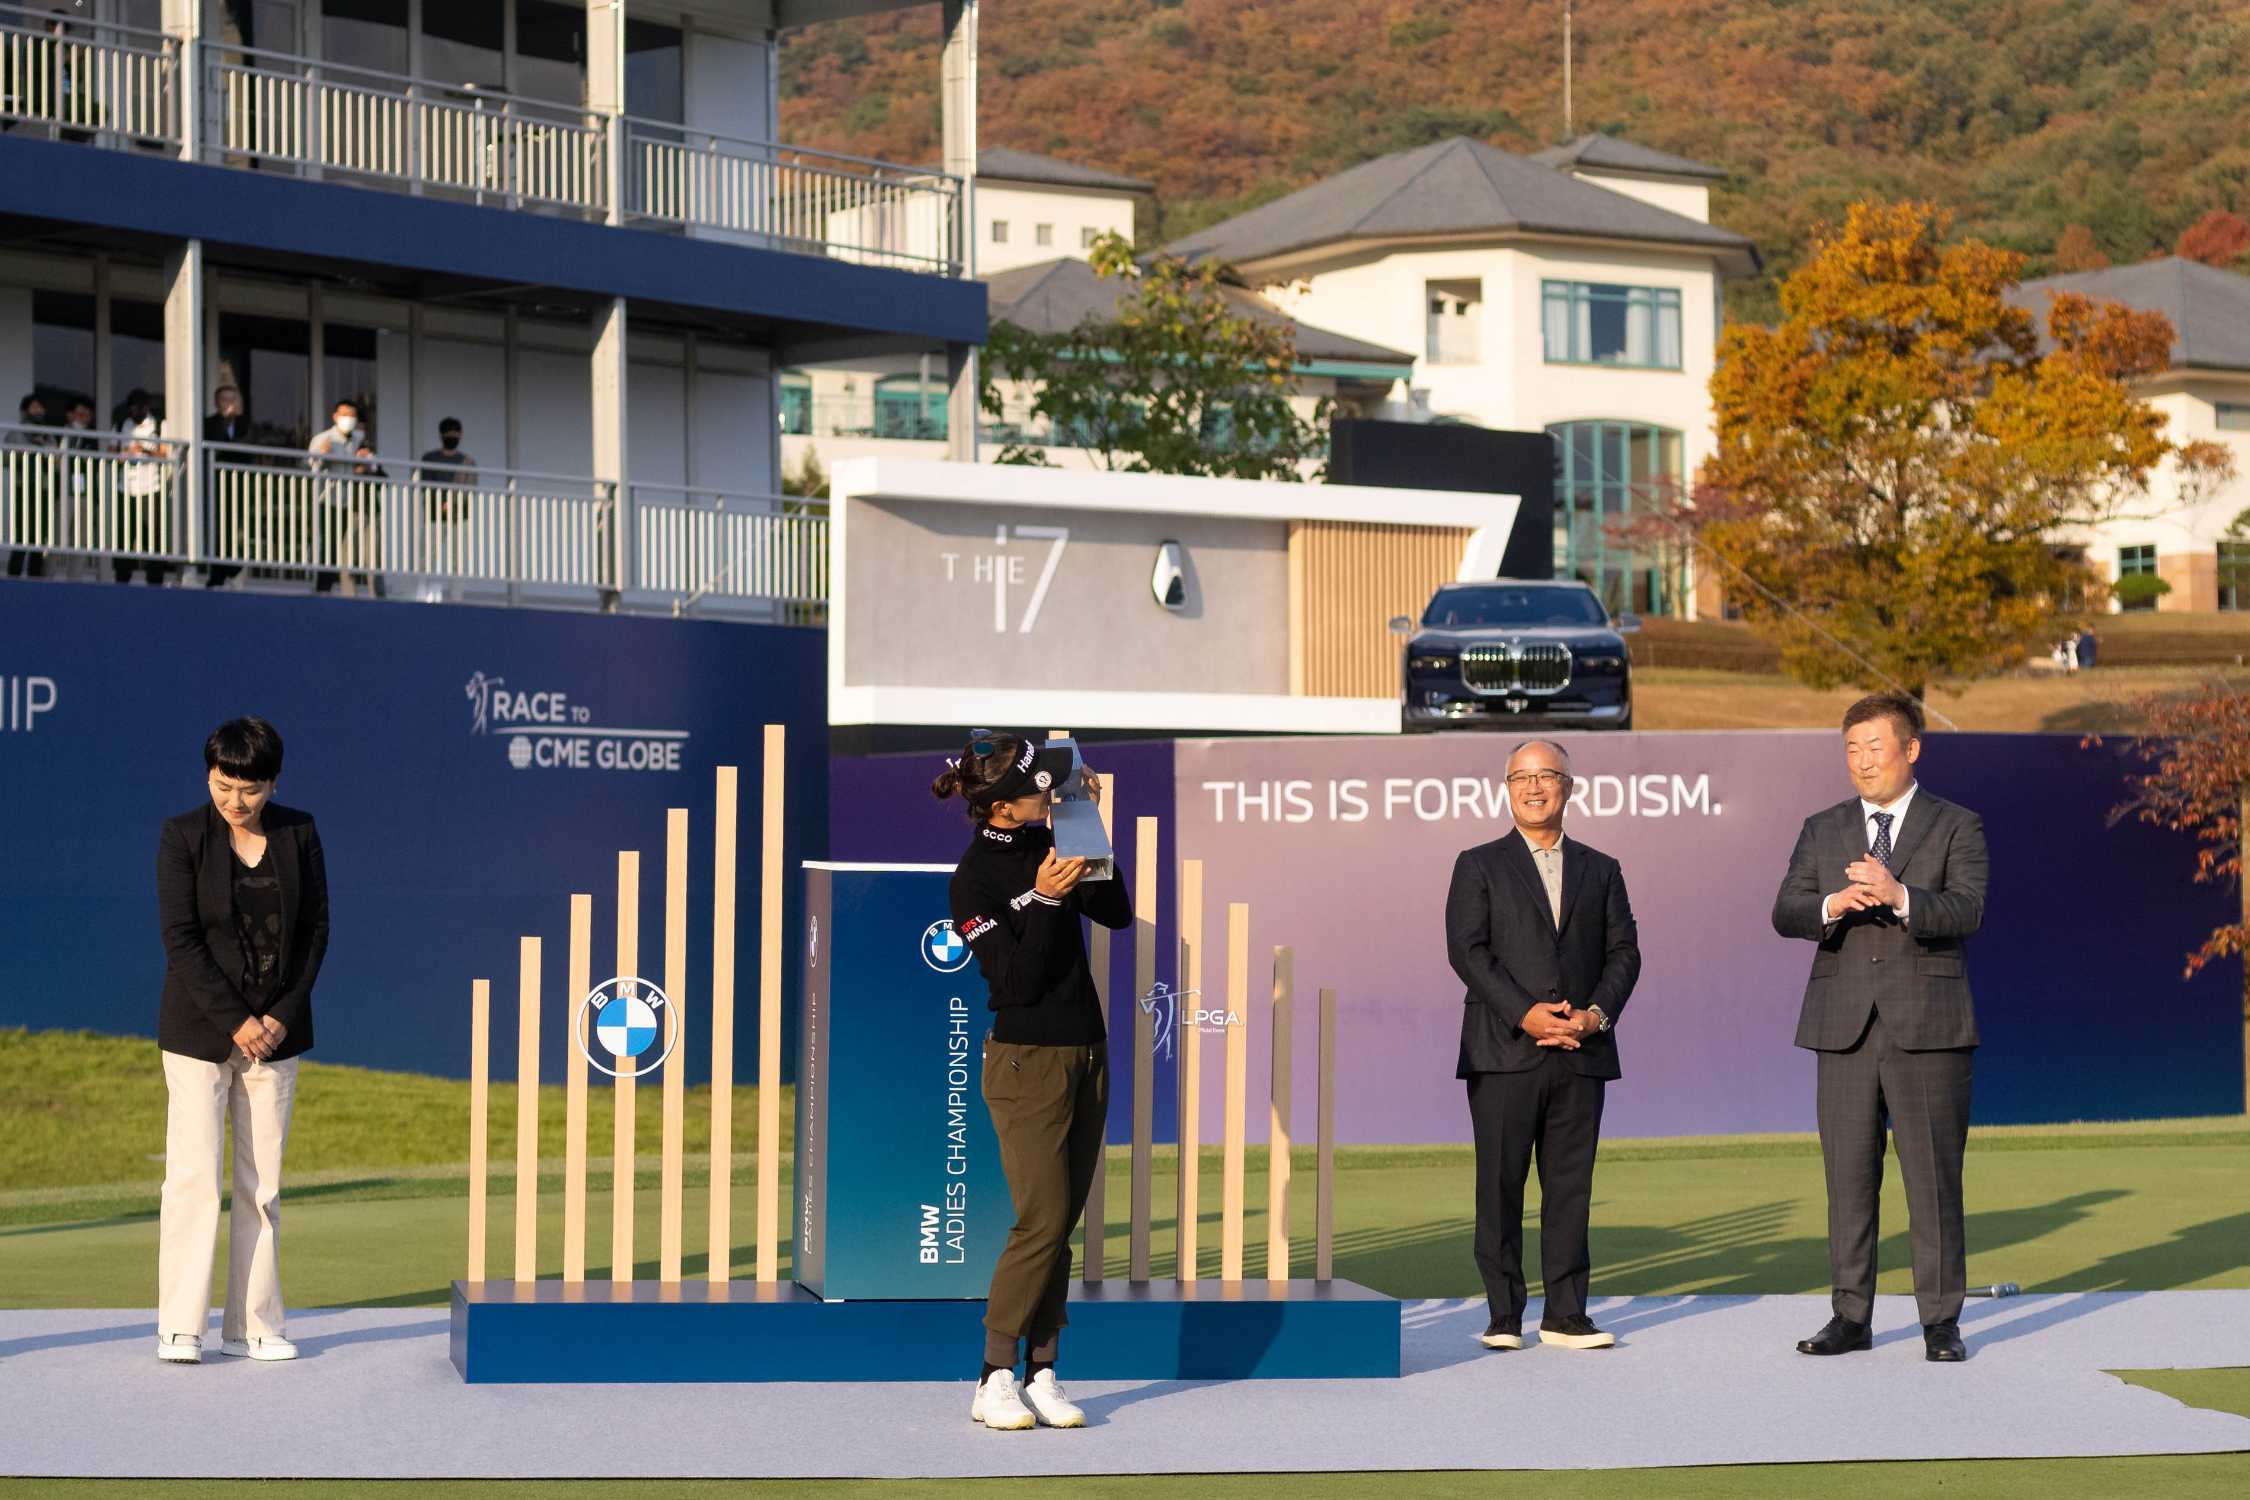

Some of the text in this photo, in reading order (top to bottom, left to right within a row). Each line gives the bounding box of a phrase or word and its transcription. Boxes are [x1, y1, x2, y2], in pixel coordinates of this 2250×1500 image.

[940, 553, 1025, 584] THE
[0, 675, 57, 732] IP
[493, 690, 591, 723] RACE TO
[535, 737, 681, 770] CME GLOBE
[1202, 774, 1722, 824] THIS IS FORWRDISM.
[983, 829, 1012, 843] ecco
[965, 918, 998, 943] HANDA
[591, 982, 664, 1011] BMW
[1181, 1009, 1240, 1025] LPGA
[946, 997, 969, 1264] LADIES CHAMPIONSHIP
[920, 1204, 940, 1264] BMW
